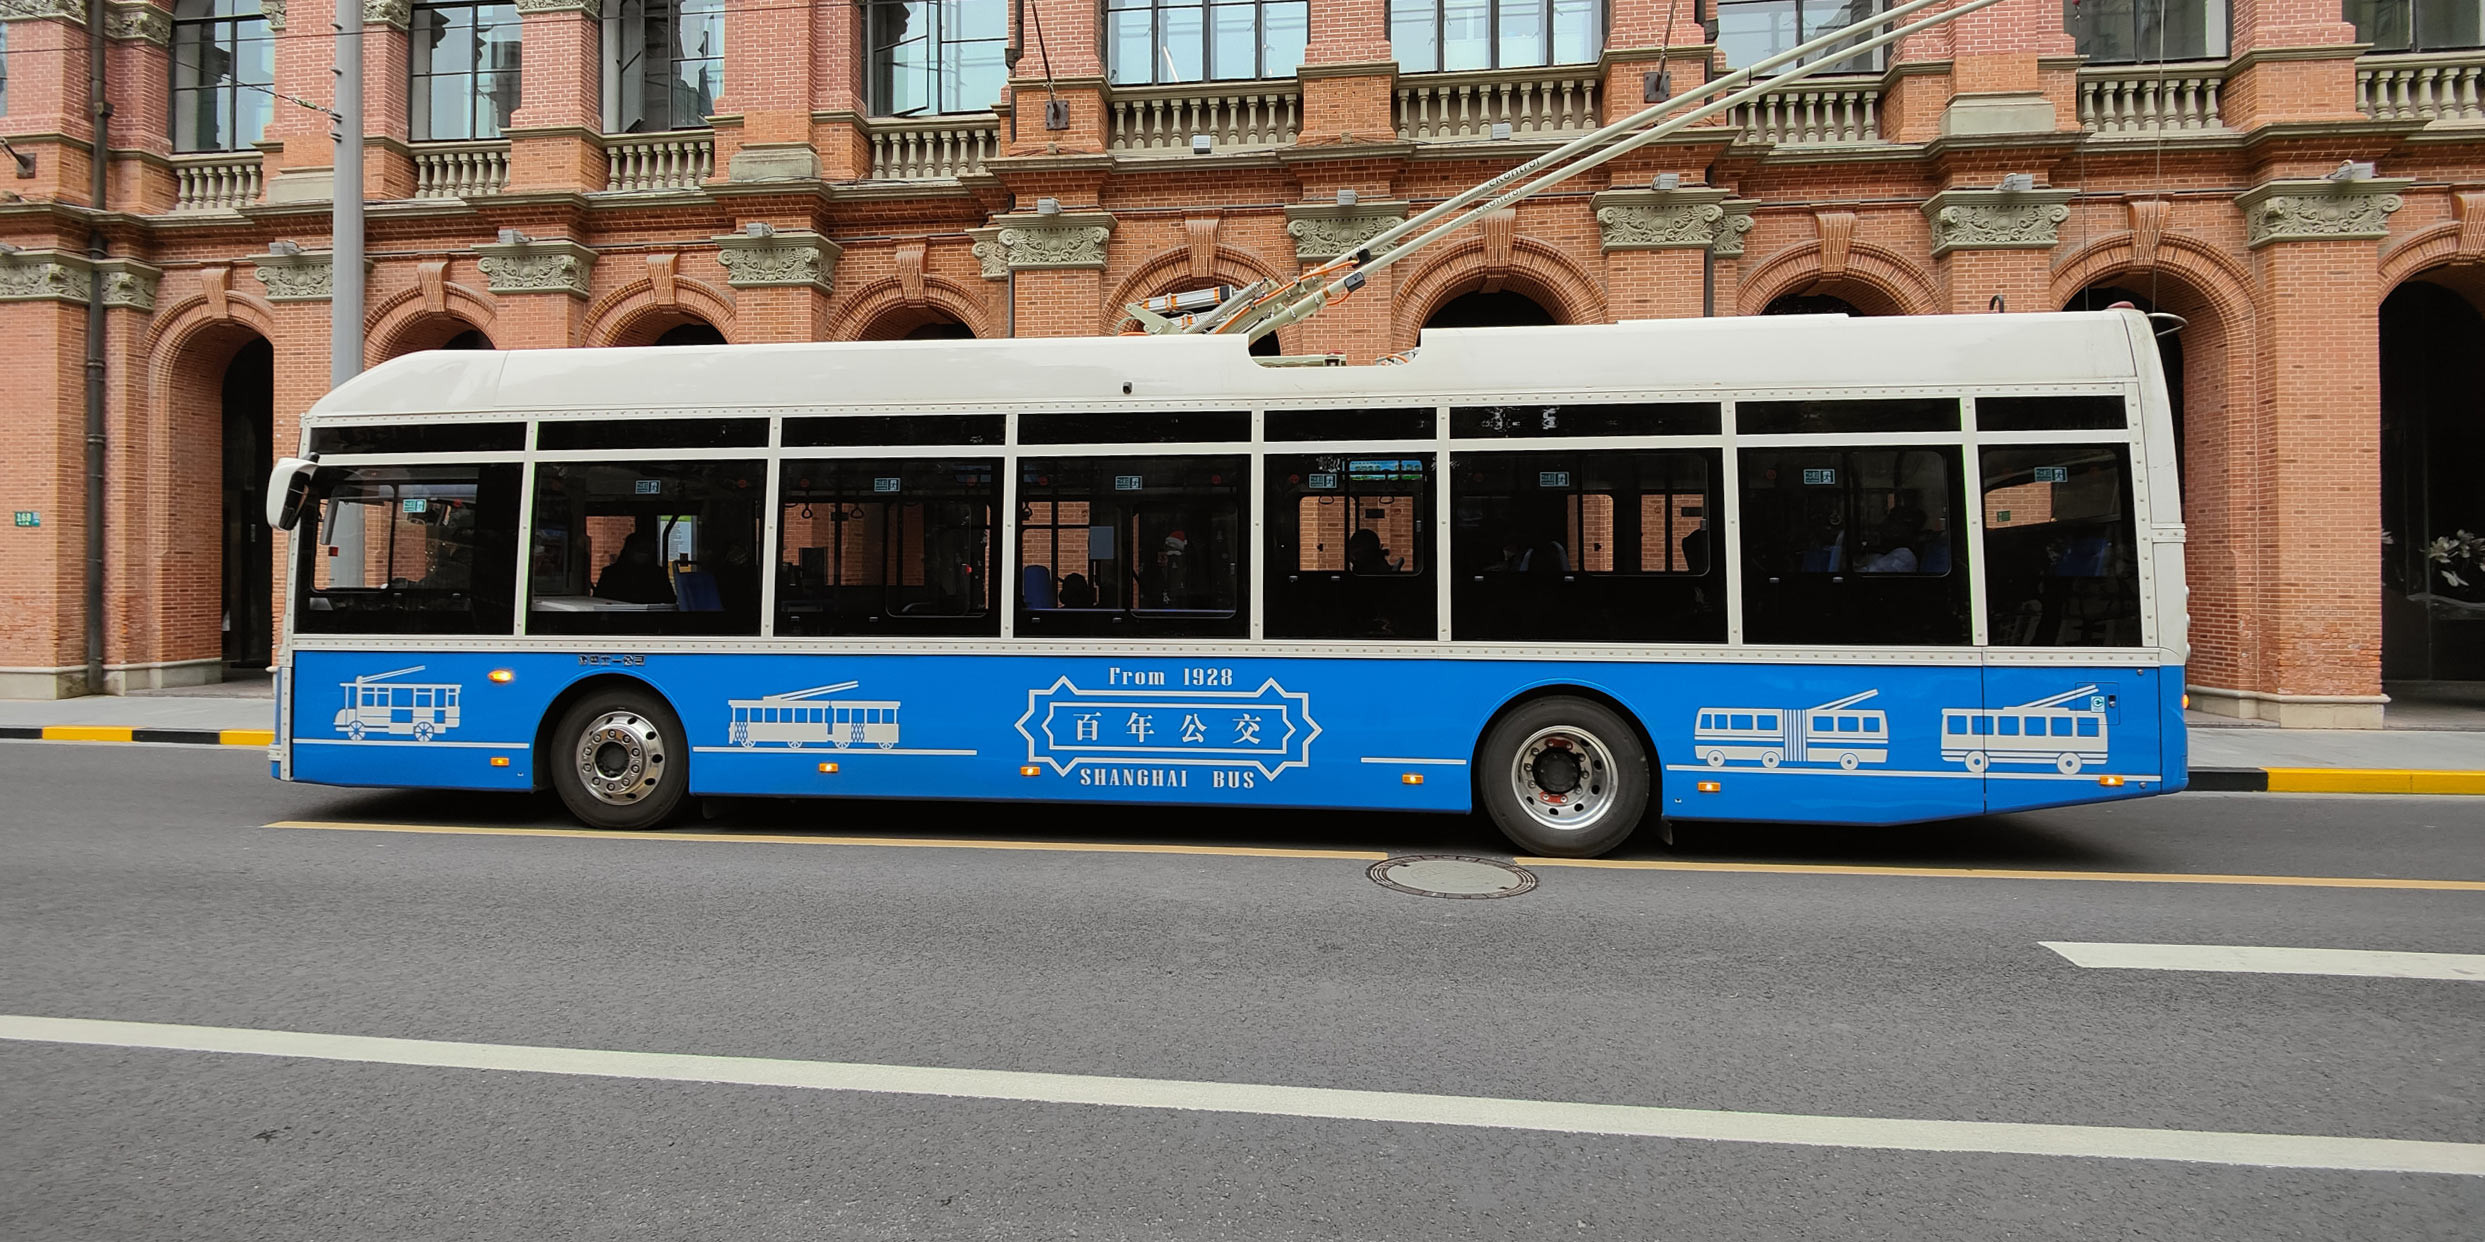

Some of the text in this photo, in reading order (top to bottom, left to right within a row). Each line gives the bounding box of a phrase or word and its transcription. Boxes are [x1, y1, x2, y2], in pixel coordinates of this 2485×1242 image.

[1109, 667, 1233, 686] From 1928
[1073, 711, 1262, 745] 百年公交
[1080, 768, 1255, 789] SHANGHAI BUS
